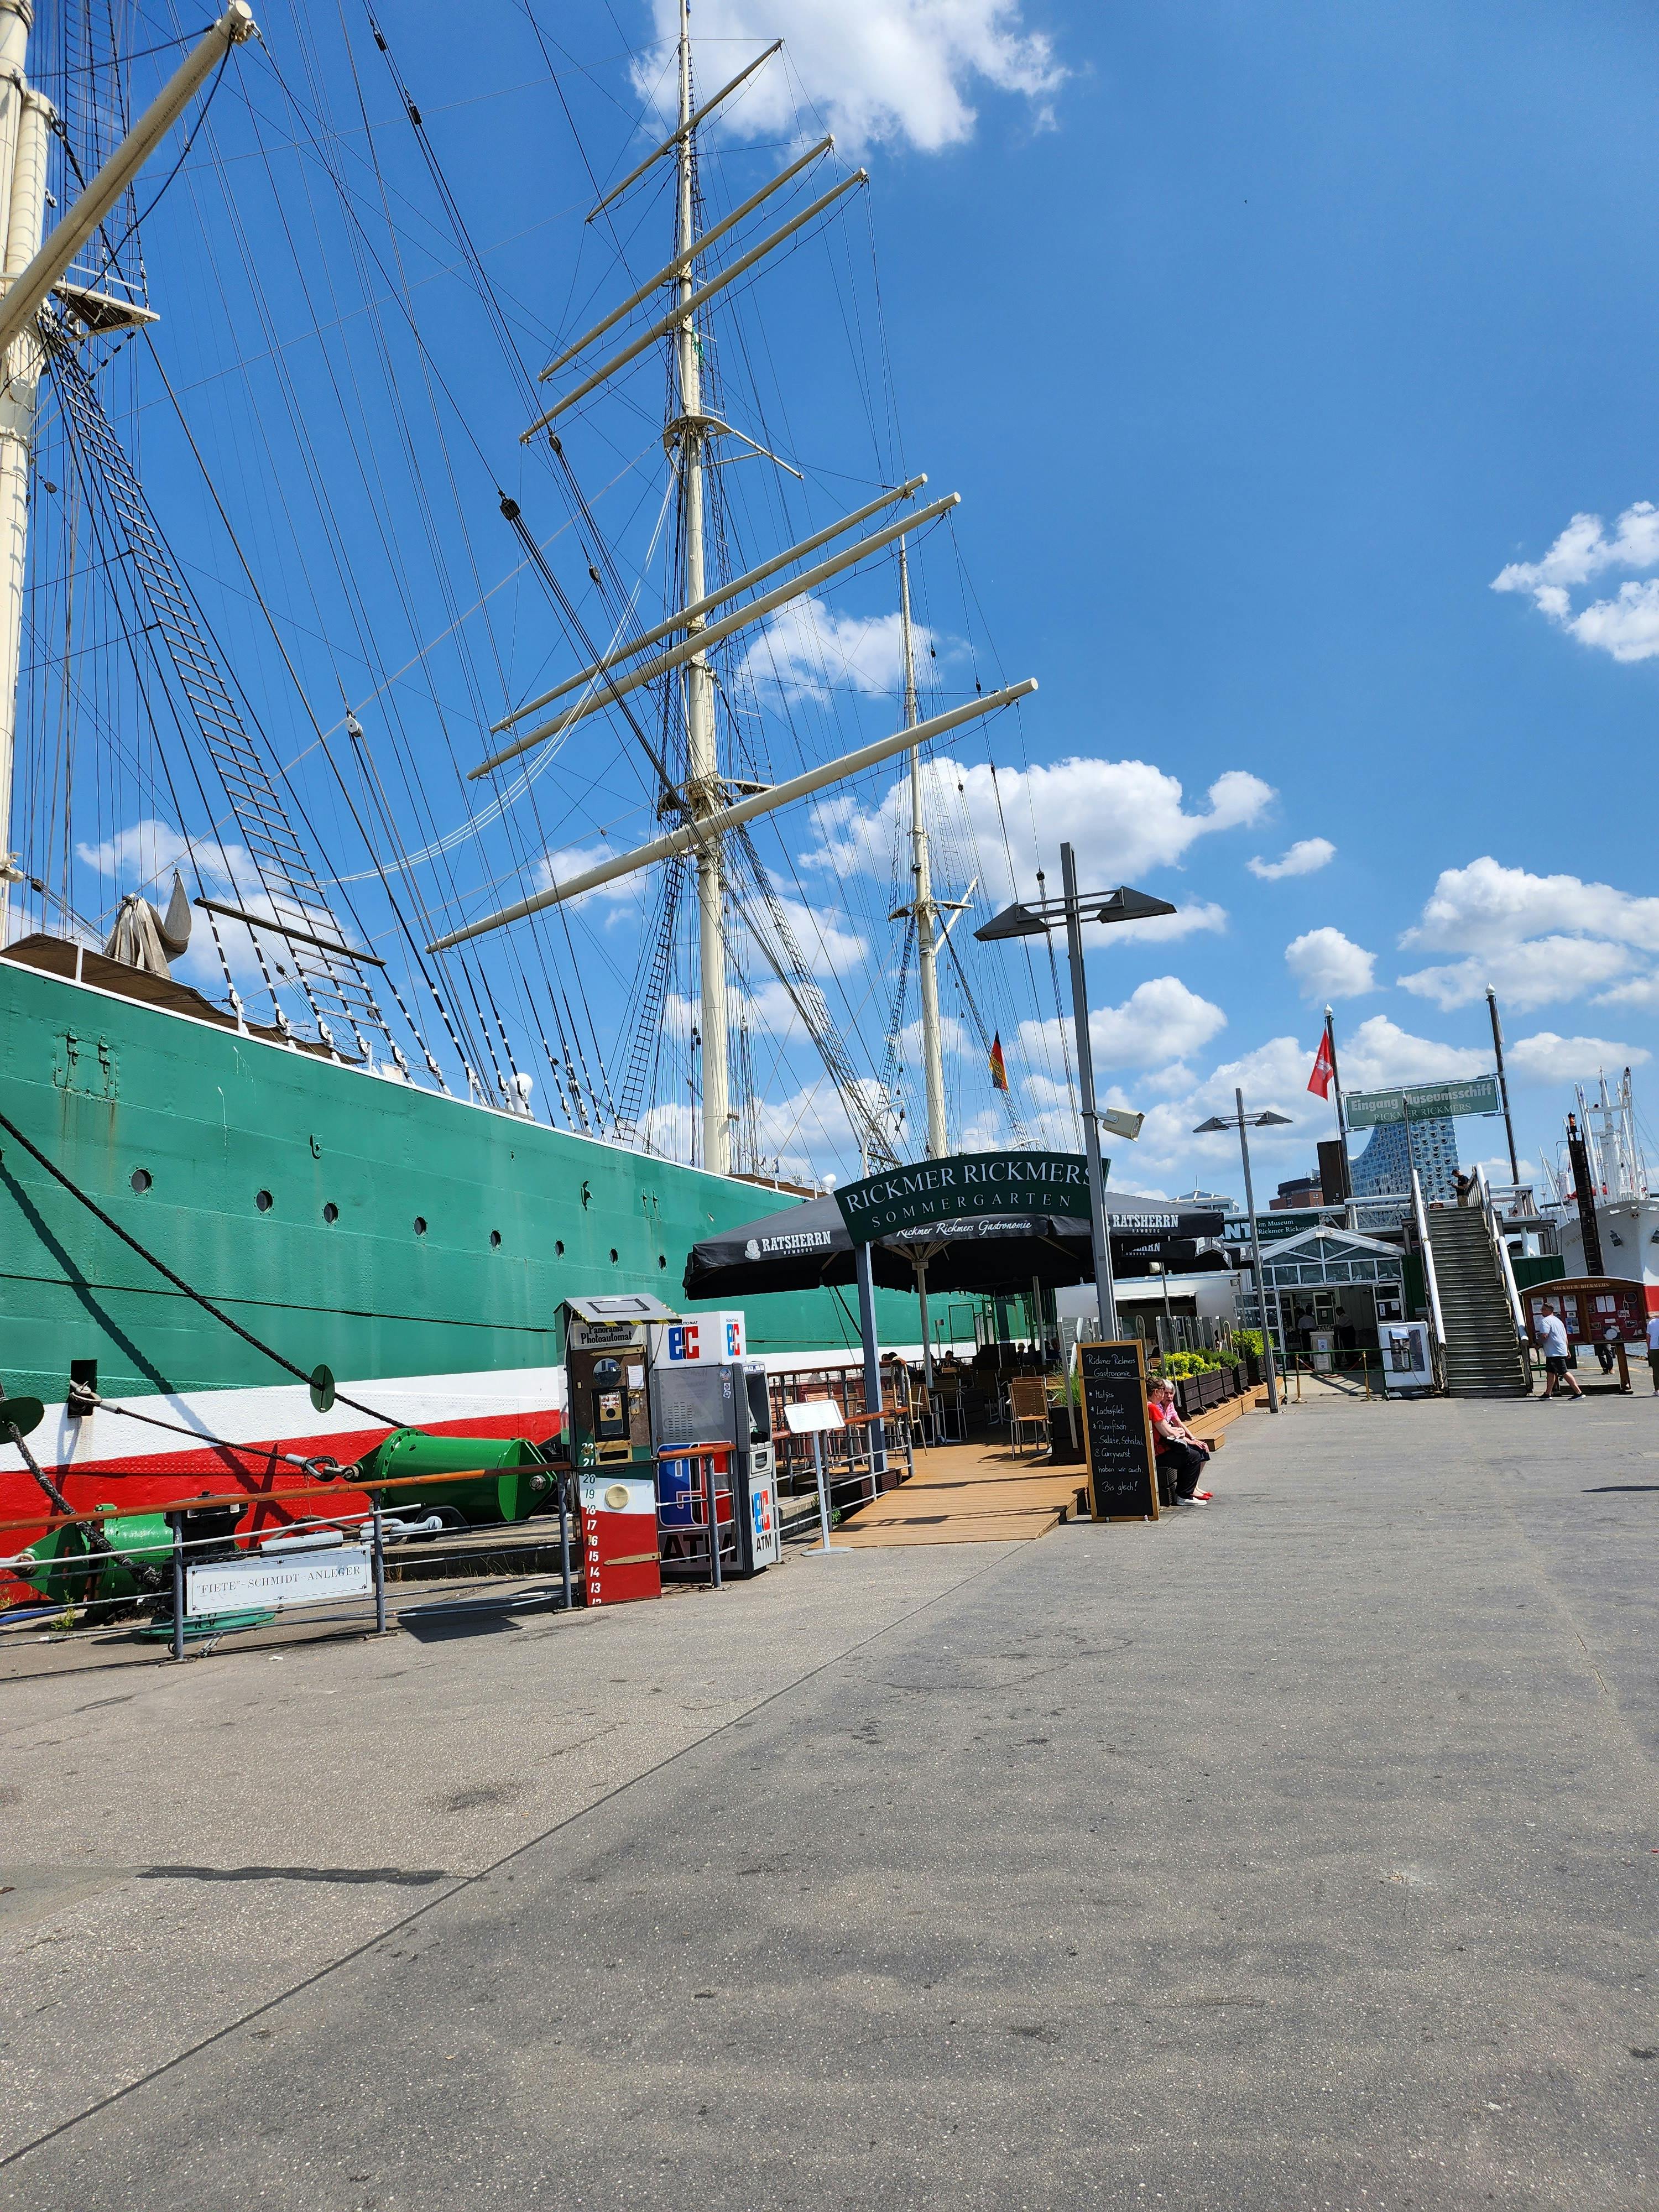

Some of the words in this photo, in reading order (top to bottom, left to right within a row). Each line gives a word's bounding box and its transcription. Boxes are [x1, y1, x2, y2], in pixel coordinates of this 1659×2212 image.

[1351, 1099, 1399, 1112] Eingang
[1402, 1083, 1492, 1106] Museumsschiff
[1374, 1109, 1418, 1121] RICKMER
[1421, 1103, 1472, 1115] RICKMERS
[845, 1167, 957, 1214] RICKMER
[964, 1161, 1091, 1187] RICKMERS
[872, 1192, 1071, 1228] SOMMERGARTEN
[1113, 1214, 1179, 1228] RATSHERRN
[896, 1227, 933, 1238] Rickmer
[936, 1218, 974, 1235] Rickmers
[979, 1219, 1033, 1237] Gastronomie
[761, 1230, 832, 1252] RATSHERRN
[783, 1247, 813, 1255] HAMBURG
[588, 1326, 624, 1334] Panorama
[581, 1331, 633, 1344] Photoautomat
[1086, 1354, 1111, 1365] Rickmer
[1112, 1354, 1136, 1365] Rickmers
[1094, 1368, 1132, 1377] Gastronomie
[1096, 1404, 1124, 1416] Lachsfilet
[1101, 1448, 1131, 1464] Currywurst
[583, 1458, 594, 1467] 21
[1098, 1464, 1115, 1473] haben
[583, 1473, 596, 1484] 20
[1102, 1481, 1114, 1492] Bis
[1117, 1480, 1138, 1495] gleich!
[586, 1489, 595, 1499] 19
[586, 1504, 596, 1515] 18
[587, 1520, 597, 1530] 17
[756, 1533, 772, 1552] ATM
[589, 1551, 599, 1562] 15
[590, 1567, 600, 1577] 14
[591, 1582, 601, 1593] 13
